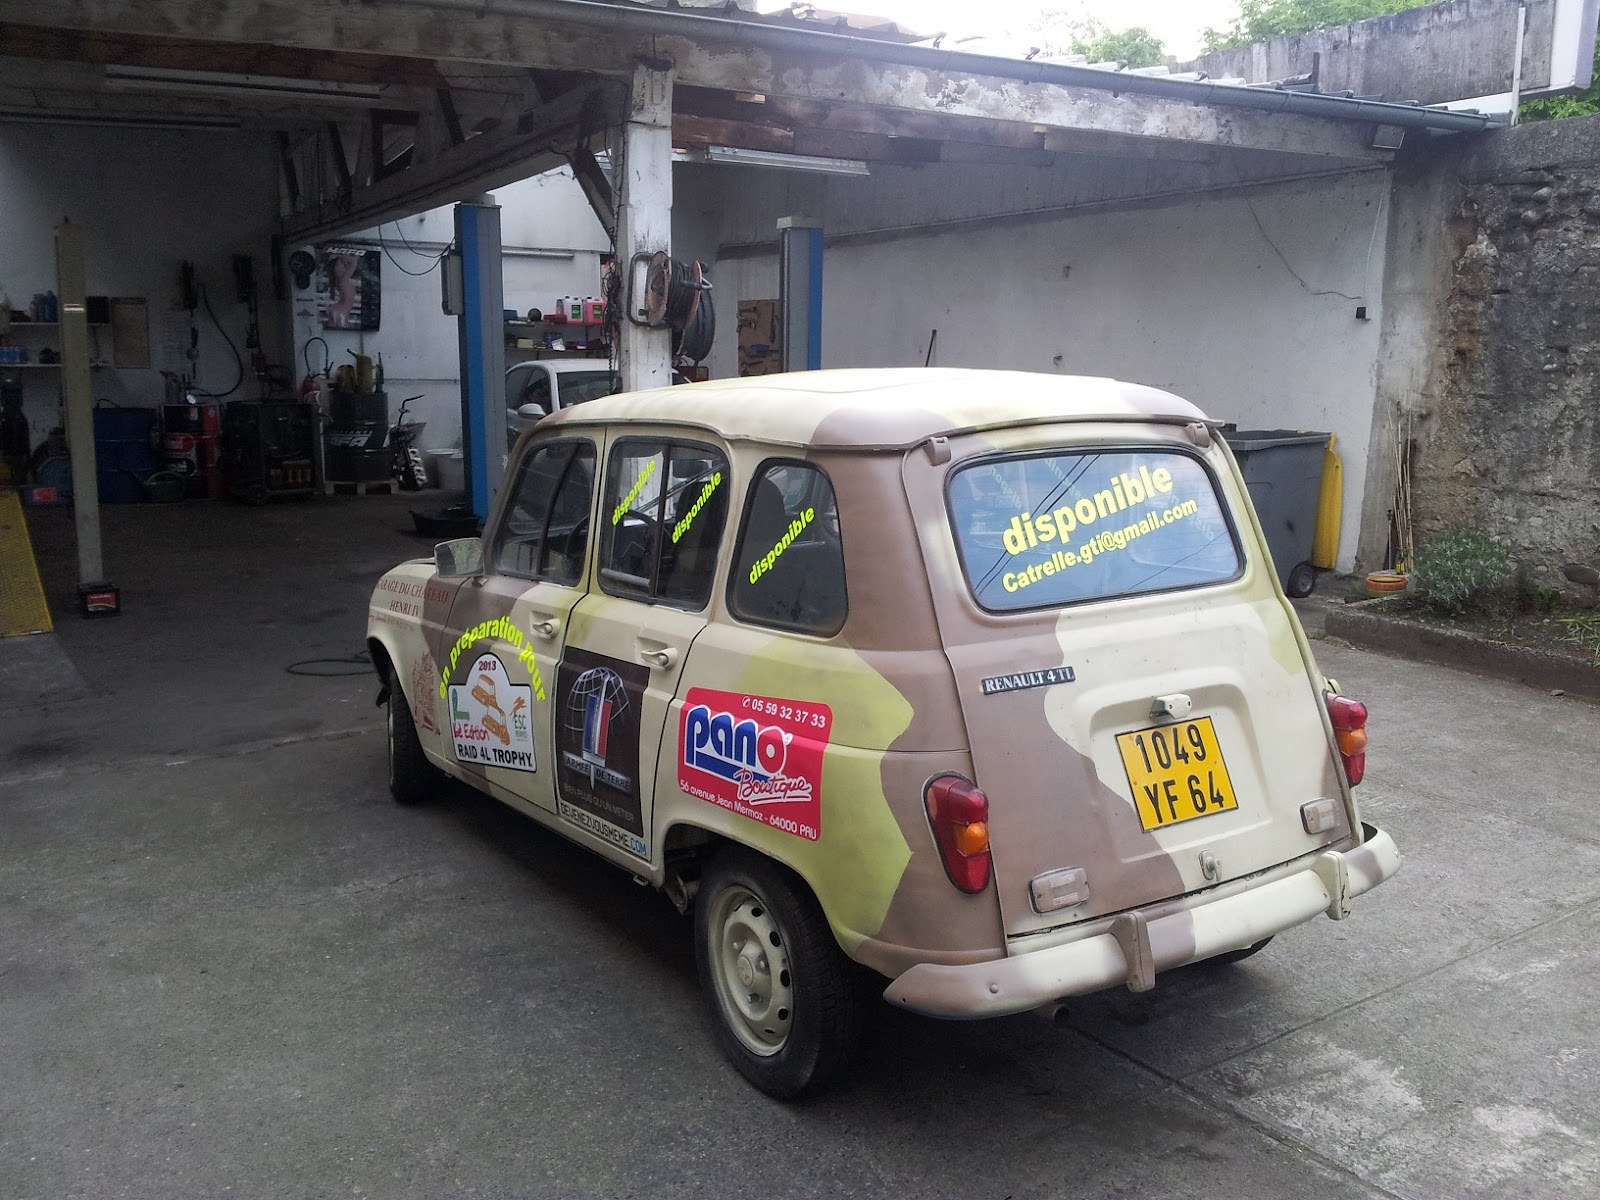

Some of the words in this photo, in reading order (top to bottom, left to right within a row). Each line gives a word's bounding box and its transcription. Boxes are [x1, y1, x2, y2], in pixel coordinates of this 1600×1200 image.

[612, 460, 656, 526] disponible
[672, 471, 722, 544] disponible
[1003, 465, 1173, 555] disponible
[749, 506, 816, 585] disponible
[1002, 499, 1198, 593] Catrelle.gti@gmail.com
[389, 600, 412, 616] HENRI
[478, 660, 497, 671] 2013
[519, 642, 546, 701] pour
[985, 671, 1044, 692] RENAULT
[1047, 670, 1056, 682] 4
[1056, 668, 1075, 680] TL
[751, 698, 764, 712] 05
[765, 702, 778, 716] 59
[779, 705, 793, 720] 32
[794, 709, 809, 724] 37
[811, 713, 826, 729] 33
[457, 743, 478, 760] RAID
[480, 746, 491, 762] 4L
[1135, 723, 1207, 773] 1049
[596, 769, 605, 780] DE
[733, 768, 813, 800] Boutique
[1143, 779, 1178, 823] YF
[1187, 770, 1224, 813] 64
[680, 779, 691, 792] 56
[690, 787, 716, 802] avenue
[715, 793, 733, 810] Jean
[733, 803, 764, 821] Mermoz
[769, 814, 798, 834] 64000
[799, 824, 817, 840] PAU
